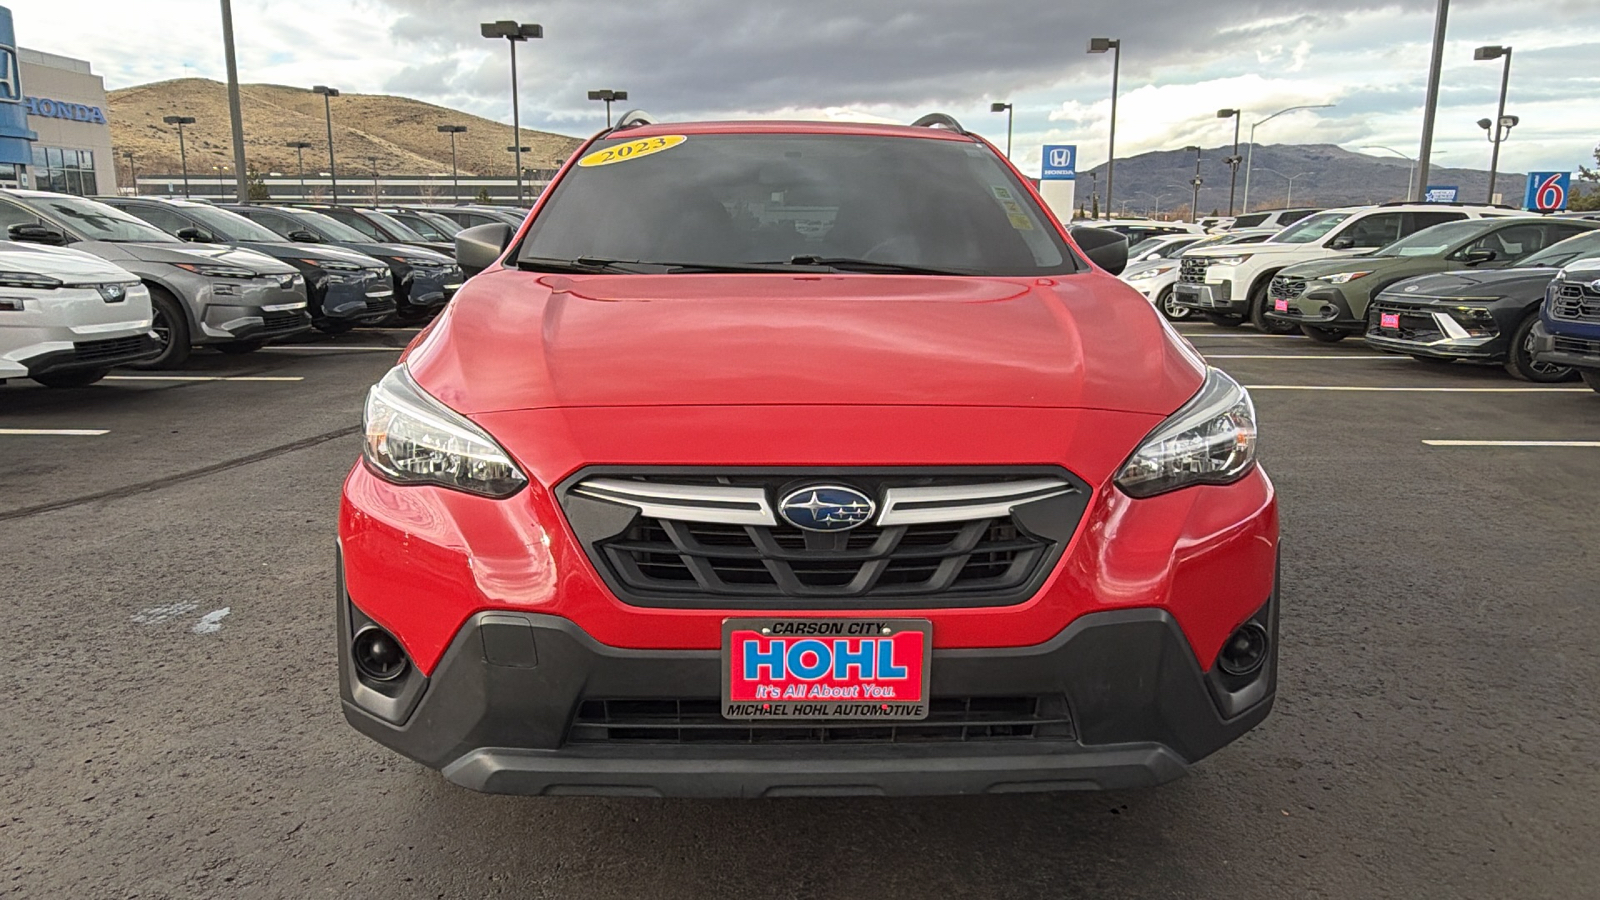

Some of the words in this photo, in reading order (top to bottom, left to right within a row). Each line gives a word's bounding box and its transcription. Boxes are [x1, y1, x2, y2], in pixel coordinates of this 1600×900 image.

[601, 138, 666, 162] 2023
[1535, 173, 1564, 210] 6
[772, 622, 843, 634] CARSON
[847, 622, 886, 634] CITY
[743, 639, 908, 680] HOHL
[755, 684, 780, 699] It's
[783, 684, 806, 697] All
[808, 684, 859, 698] About
[862, 684, 896, 698] You.
[727, 704, 788, 717] MICHAEL
[793, 704, 830, 717] HOHL
[833, 704, 924, 717] AUTOMOTIVE
